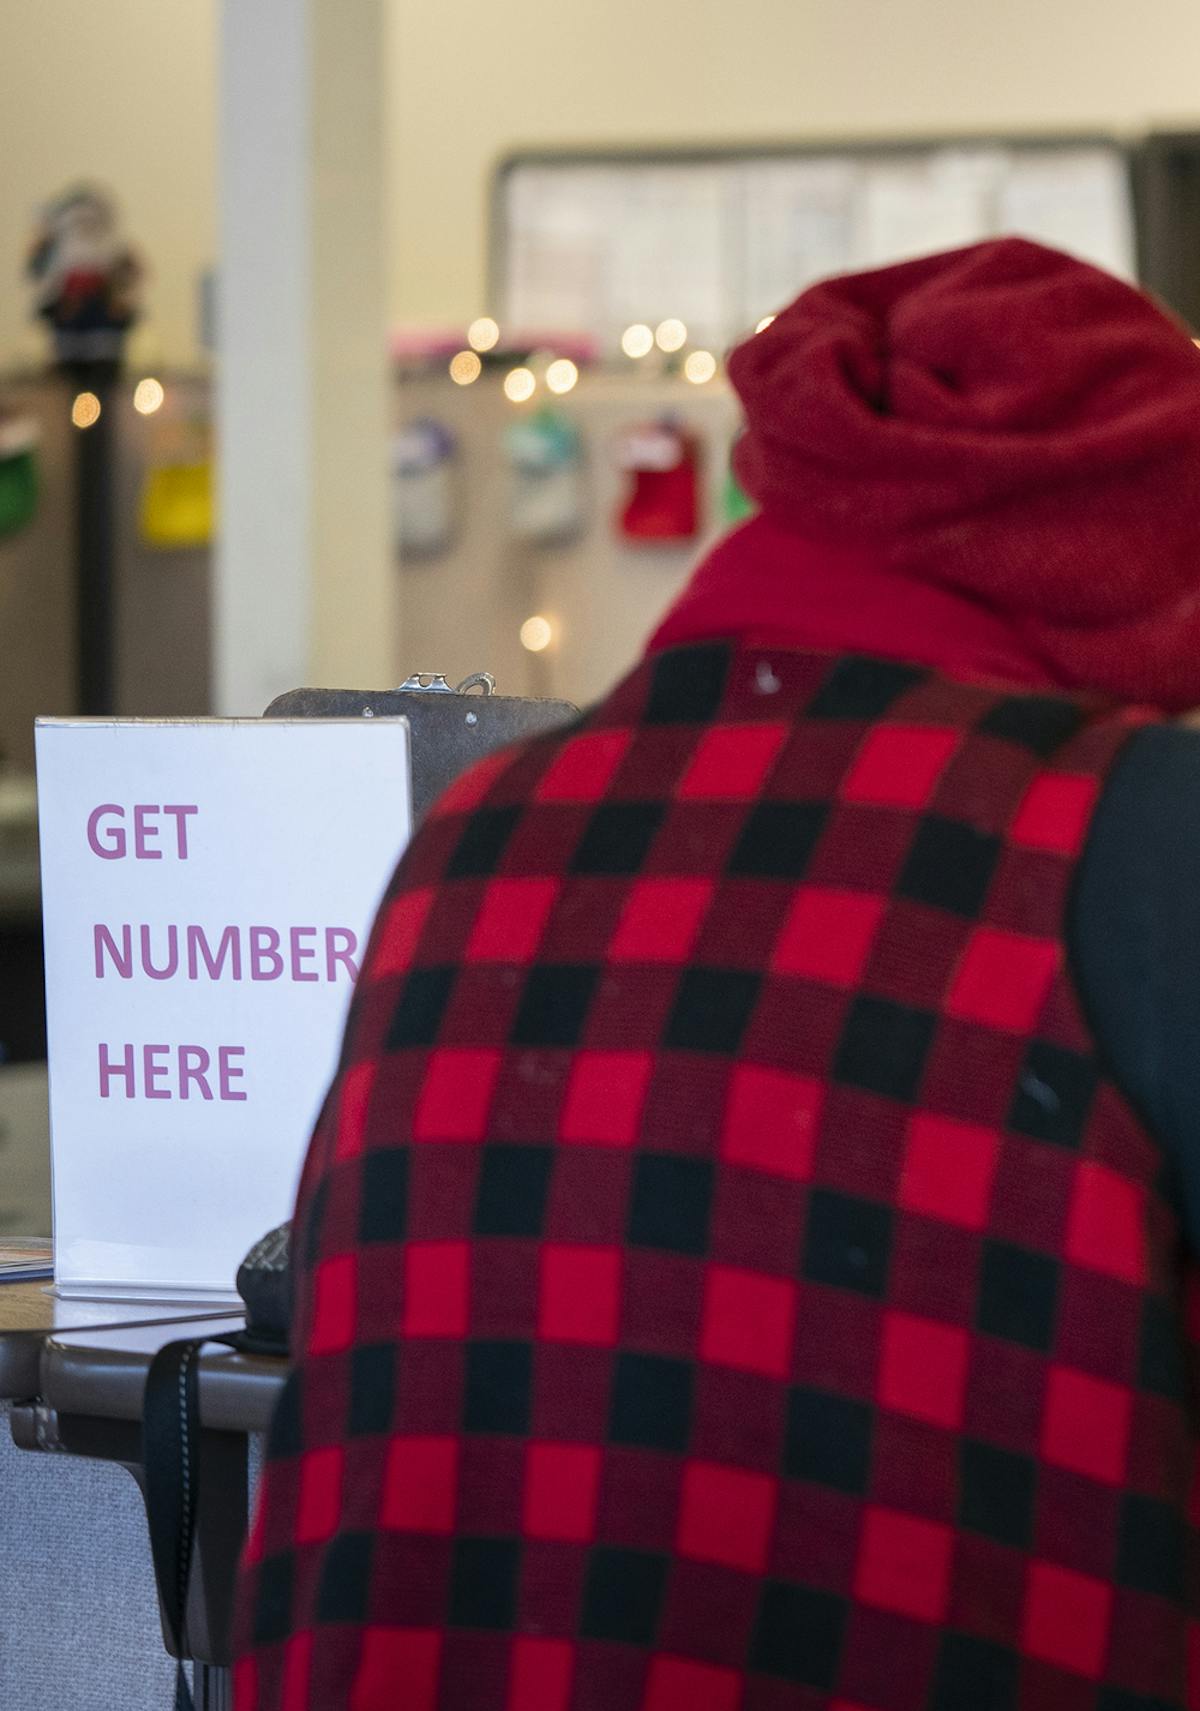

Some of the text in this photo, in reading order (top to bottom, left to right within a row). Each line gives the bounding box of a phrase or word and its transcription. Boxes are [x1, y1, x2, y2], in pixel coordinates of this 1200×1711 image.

[87, 804, 198, 860] GET
[94, 924, 358, 982] NUMBER
[98, 1043, 248, 1101] HERE
